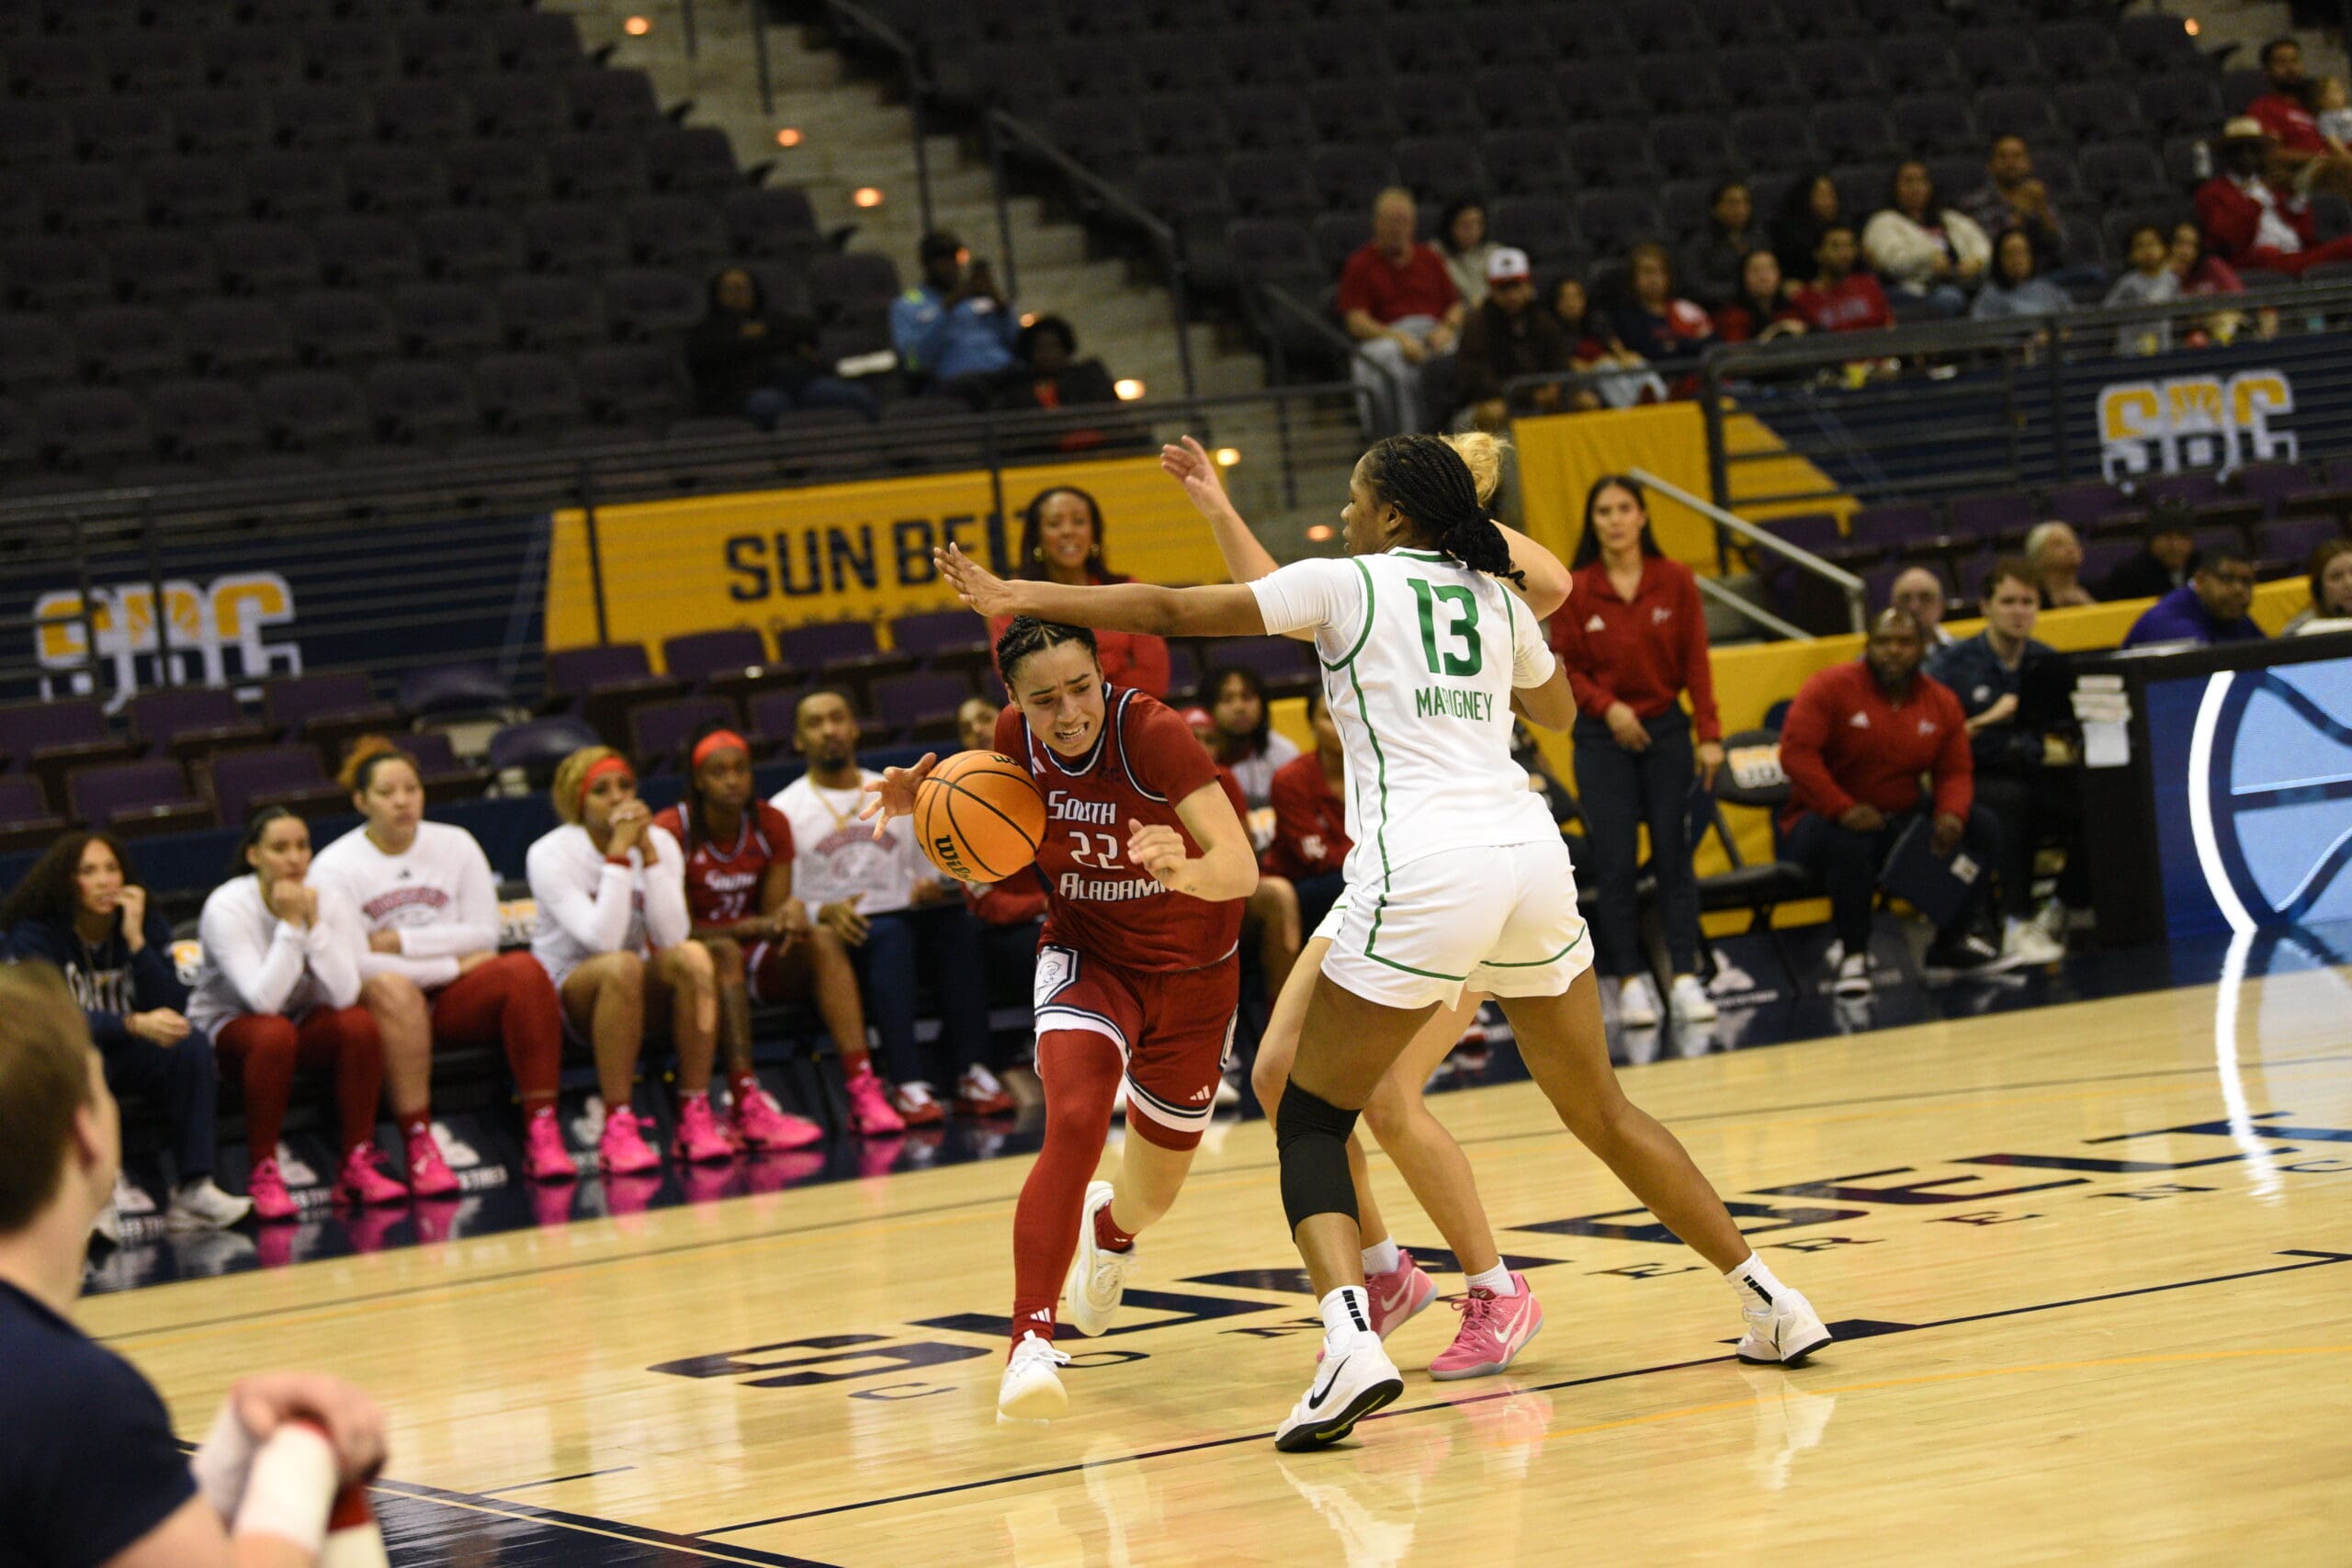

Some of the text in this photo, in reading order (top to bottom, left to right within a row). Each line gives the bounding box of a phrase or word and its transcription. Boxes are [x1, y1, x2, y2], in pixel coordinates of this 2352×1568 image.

[724, 523, 879, 604] SUN
[1407, 578, 1482, 677] 13
[1069, 830, 1125, 870] 22
